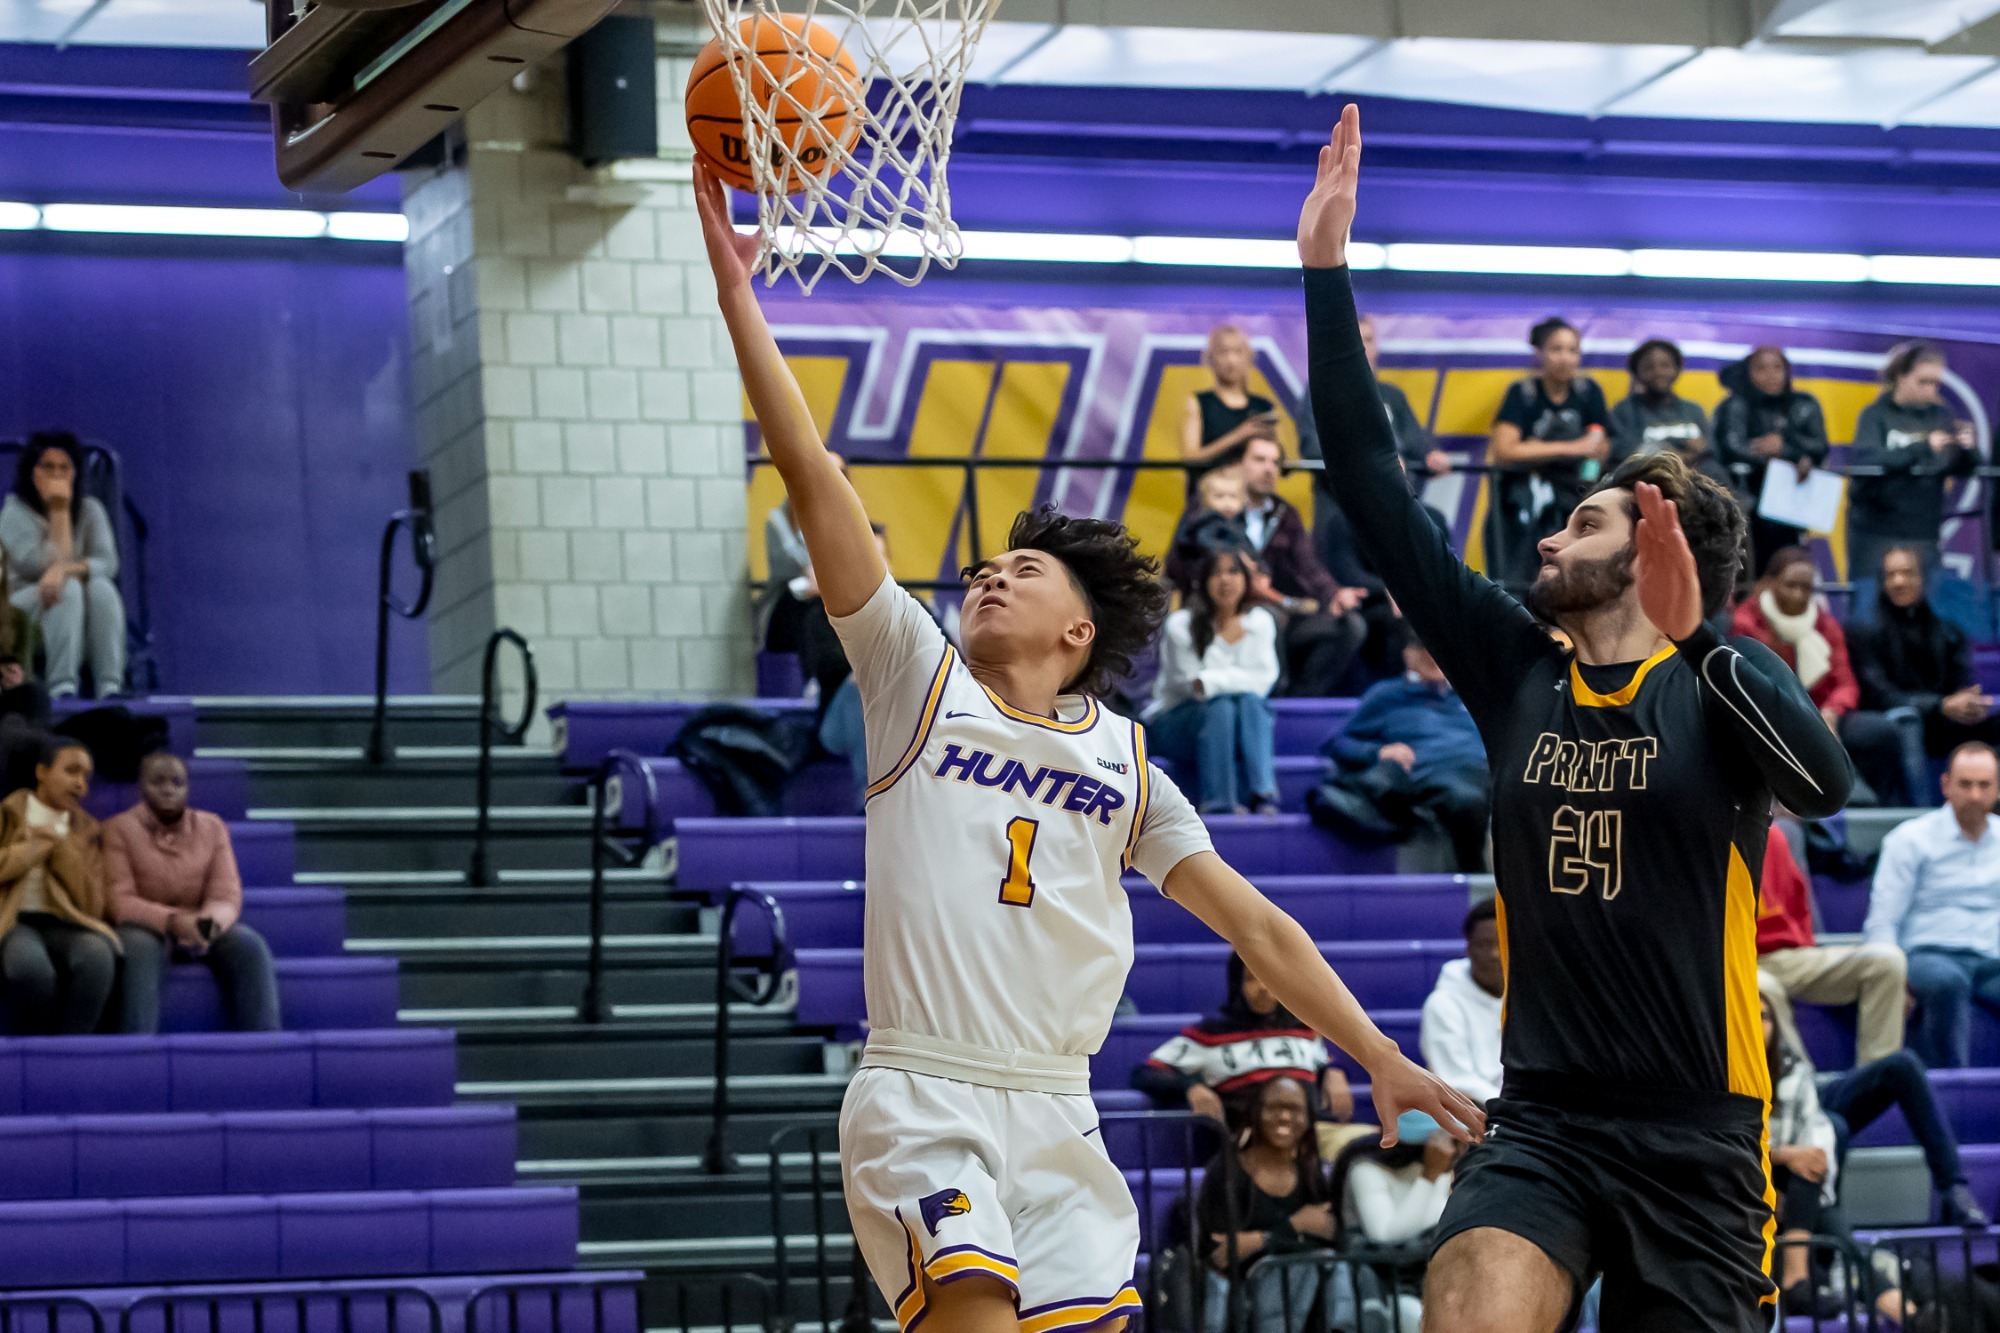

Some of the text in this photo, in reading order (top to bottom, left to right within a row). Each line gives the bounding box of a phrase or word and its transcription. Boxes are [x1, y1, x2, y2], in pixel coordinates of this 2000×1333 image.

[719, 132, 843, 167] Wlo
[932, 742, 1126, 827] HUNTER
[1096, 756, 1128, 775] CUNY
[1523, 732, 1657, 791] PRATT
[998, 816, 1039, 908] 1
[1549, 805, 1621, 900] 24
